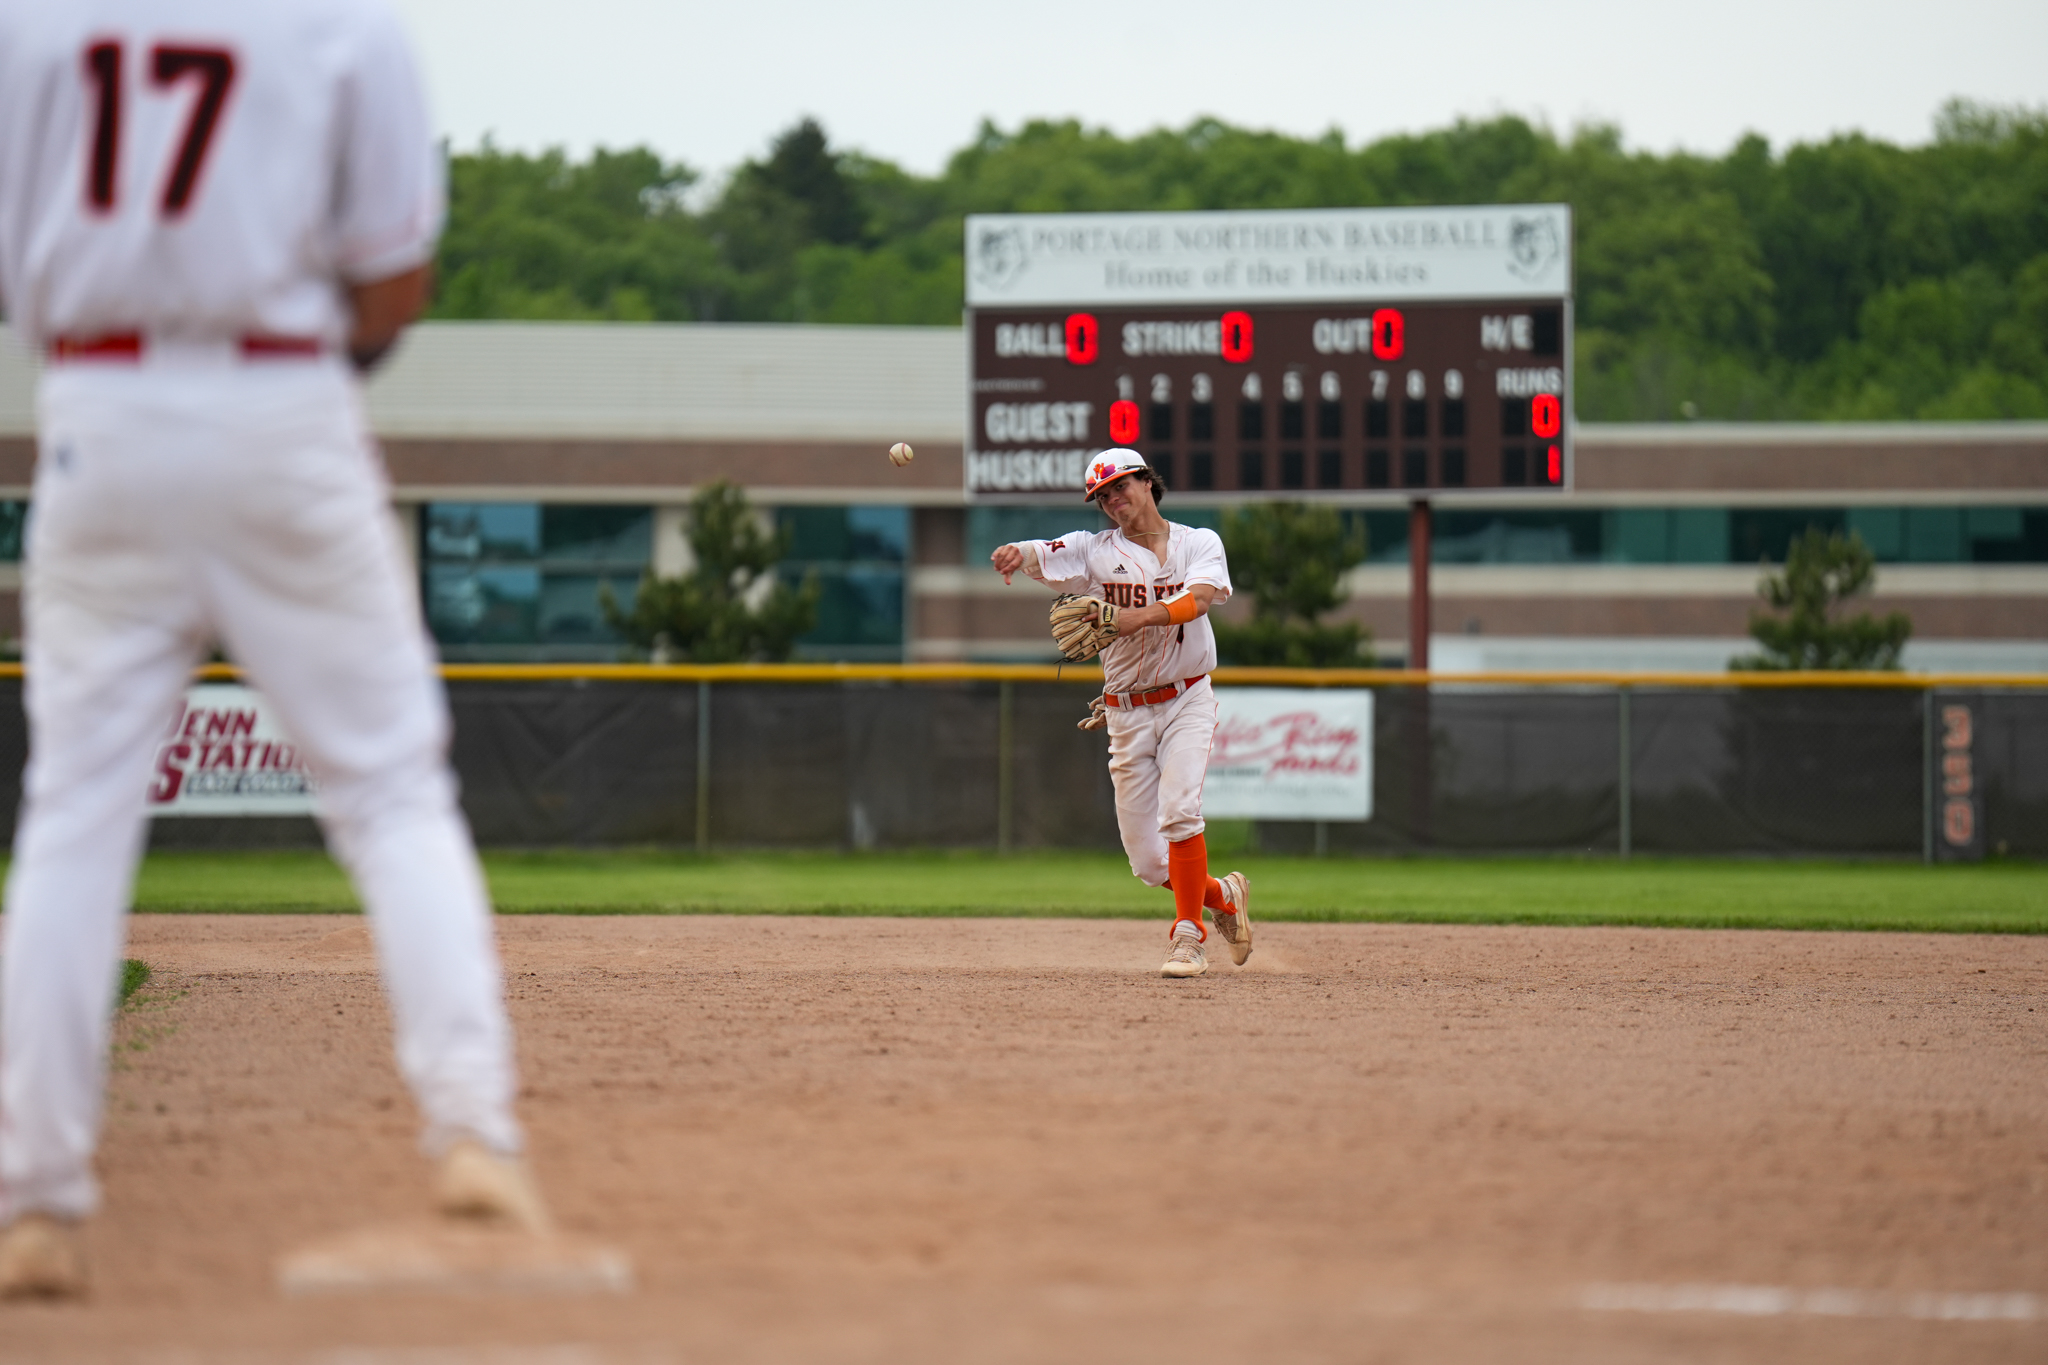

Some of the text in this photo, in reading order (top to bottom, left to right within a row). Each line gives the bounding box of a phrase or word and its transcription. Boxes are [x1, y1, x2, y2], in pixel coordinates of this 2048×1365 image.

[82, 37, 237, 221] 17
[1031, 219, 1496, 254] PORTAGE NORTHERN BASEBALL
[1103, 256, 1429, 289] Home of the Huskies
[995, 312, 1098, 365] BALL 0
[1122, 310, 1254, 363] STRIKE 0
[1312, 308, 1404, 361] OUT 0
[1480, 314, 1534, 351] H/E
[1115, 366, 1564, 403] 1 2 3 4 5 6 7 8 9 RUNS
[985, 393, 1560, 444] GUEST 0 0
[968, 449, 1104, 491] HUSKIE
[147, 743, 304, 803] STATIO
